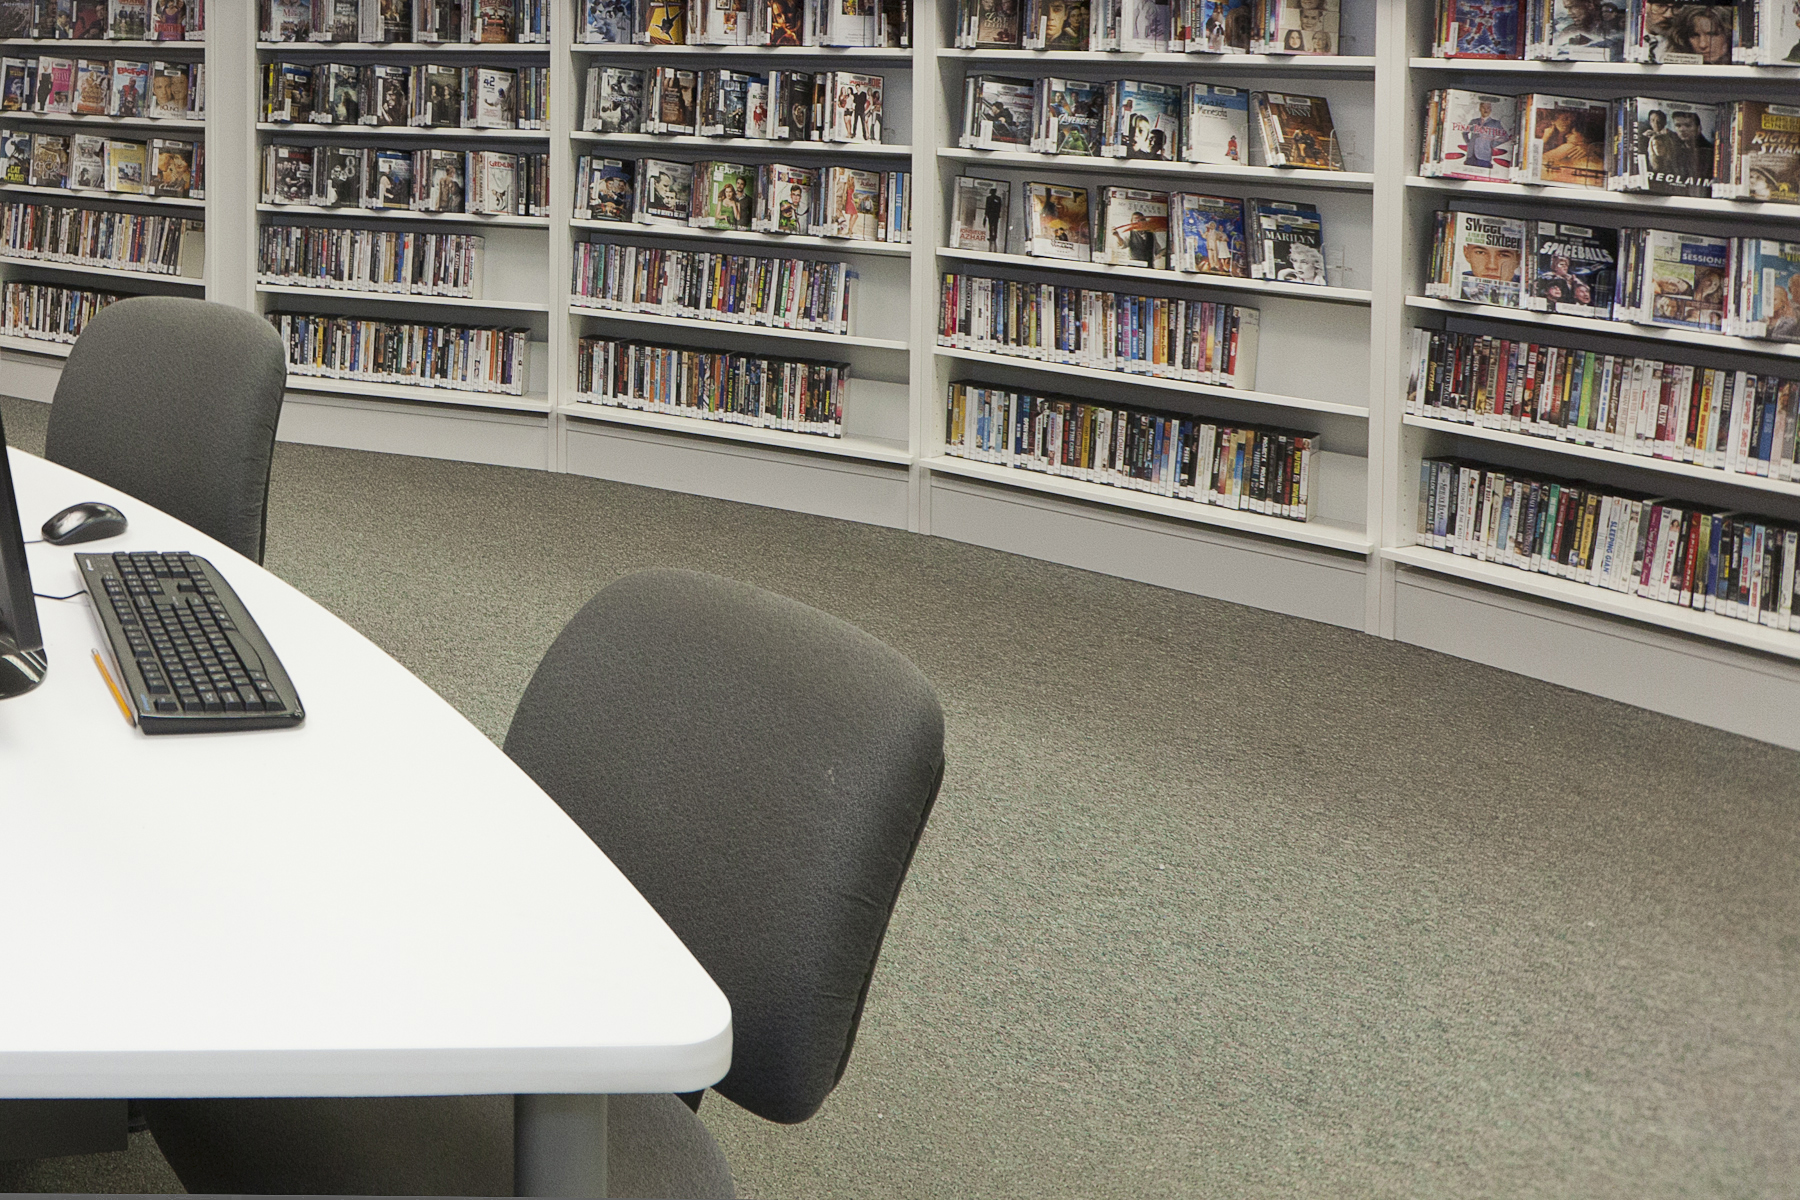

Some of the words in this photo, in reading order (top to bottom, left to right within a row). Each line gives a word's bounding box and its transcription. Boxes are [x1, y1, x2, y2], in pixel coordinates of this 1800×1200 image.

[483, 76, 495, 87] 42
[1452, 122, 1470, 134] PINK
[1751, 131, 1788, 145] RICH
[9, 165, 20, 174] CAT
[488, 160, 514, 170] GREMLINS
[7, 173, 24, 182] PARIS
[1647, 171, 1712, 188] RECLAIM
[960, 233, 986, 242] AZHAR
[1264, 230, 1315, 245] MARILYN
[1540, 241, 1614, 264] SPACEBALLS
[1682, 253, 1726, 265] SESSIONS
[1447, 352, 1455, 369] RACE
[1445, 372, 1453, 381] TO
[1443, 383, 1452, 402] SPACE
[1658, 404, 1668, 426] RUDY
[1606, 521, 1617, 553] SLEEPING
[1603, 555, 1611, 574] GIAN
